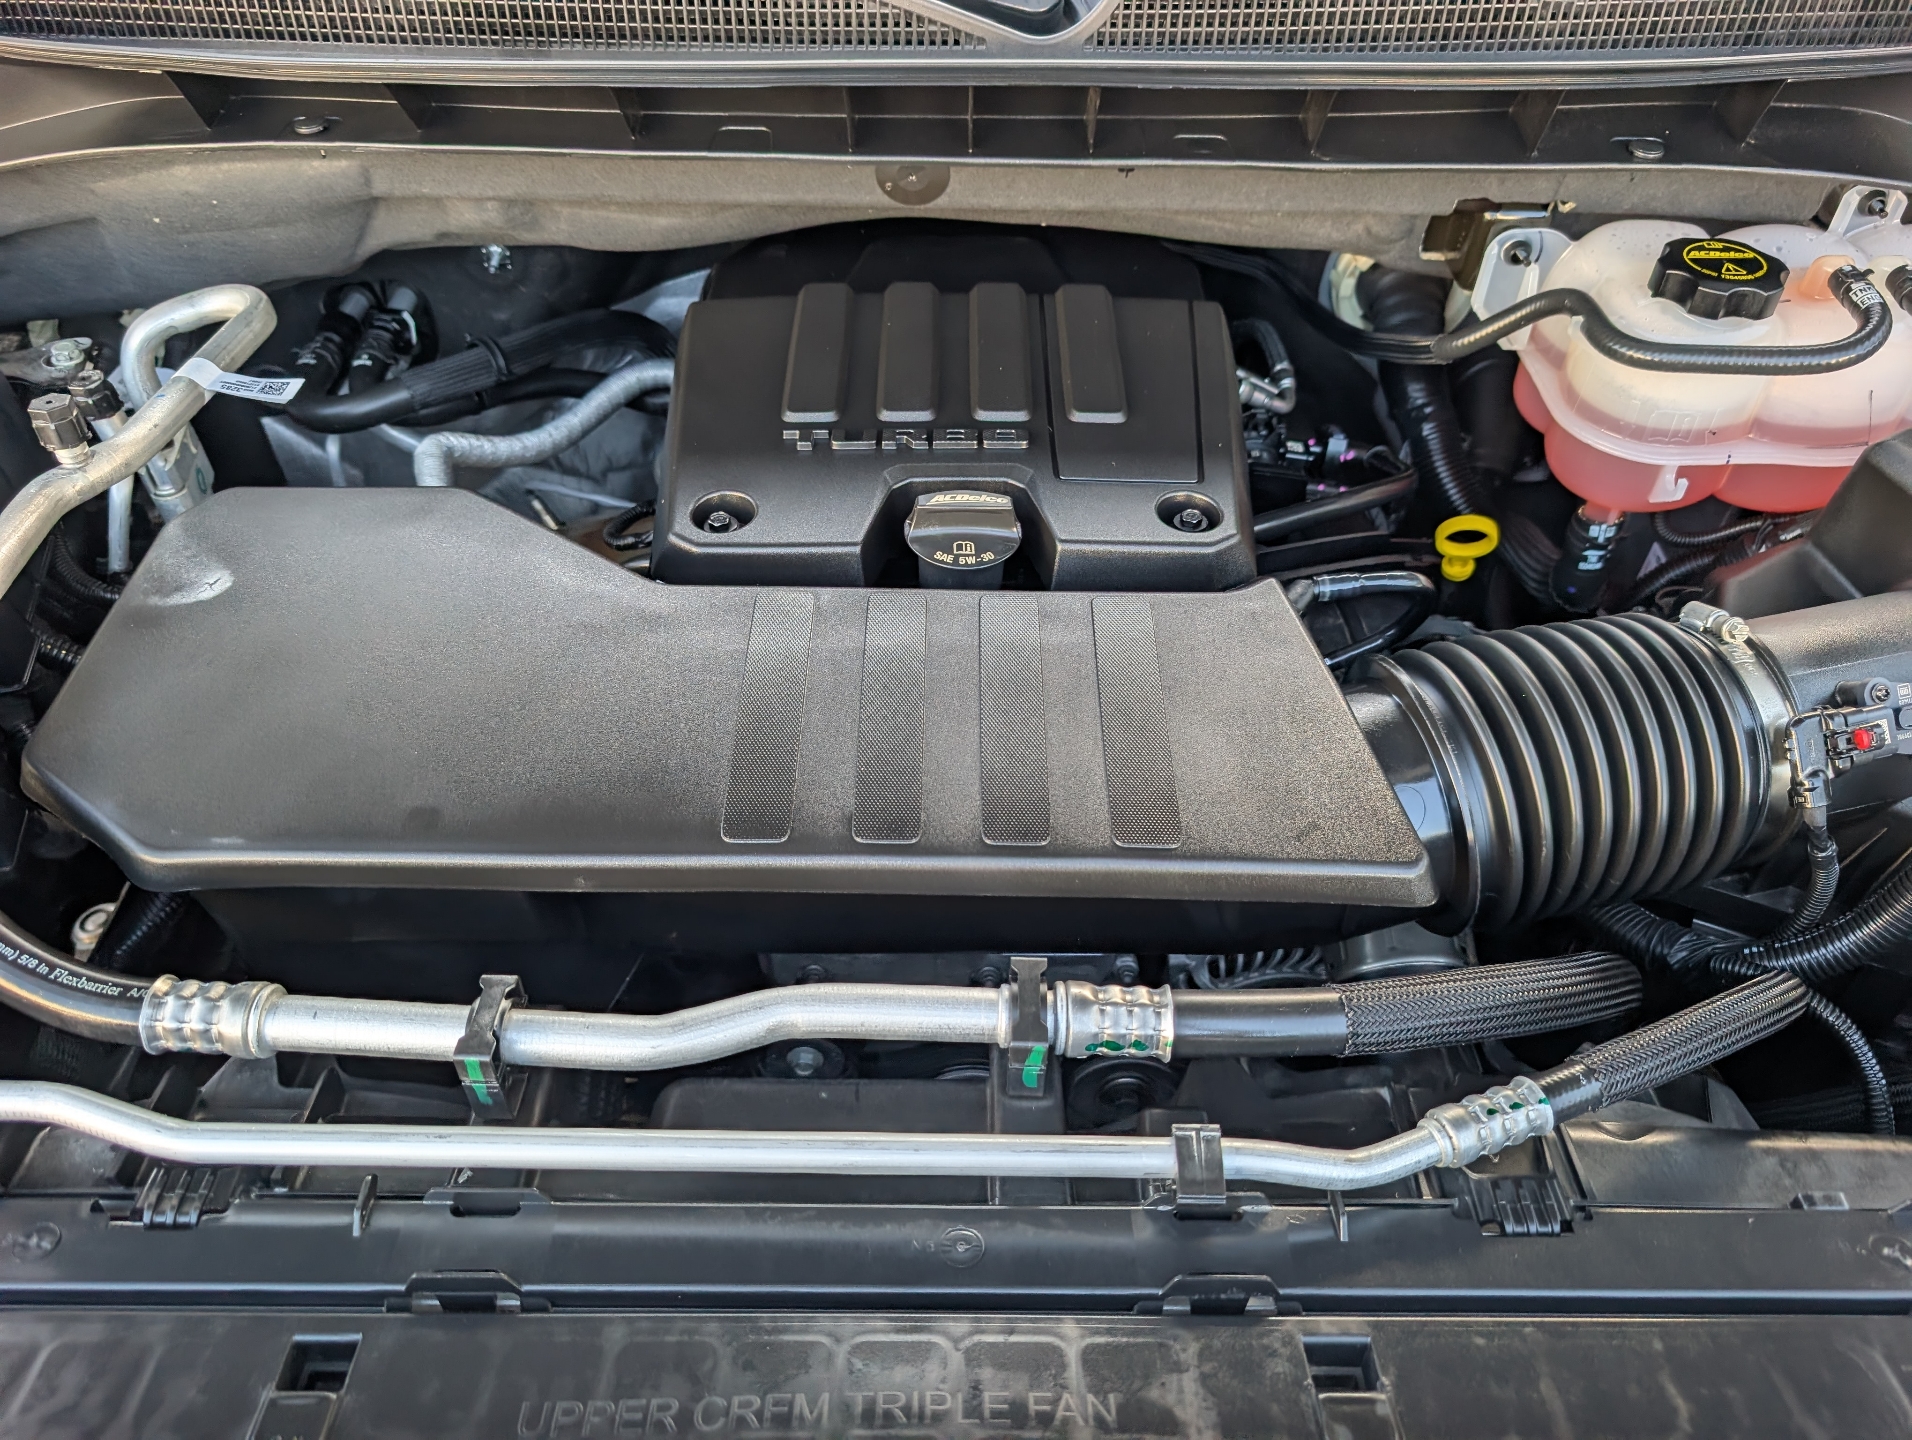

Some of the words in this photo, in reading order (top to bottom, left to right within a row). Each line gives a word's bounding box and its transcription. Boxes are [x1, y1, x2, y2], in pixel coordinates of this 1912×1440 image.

[1687, 250, 1755, 259] ACDelco
[782, 428, 1029, 451] TURBO
[926, 493, 1012, 506] ACDelco
[933, 550, 954, 565] SAE
[958, 551, 995, 565] 5W-30
[17, 954, 39, 969] 5/8
[48, 967, 124, 997] Flexbarrier
[516, 1397, 680, 1438] UPPER
[693, 1391, 829, 1433] CRFM
[846, 1390, 1012, 1426] TRIPLE
[1027, 1392, 1120, 1428] FAN
